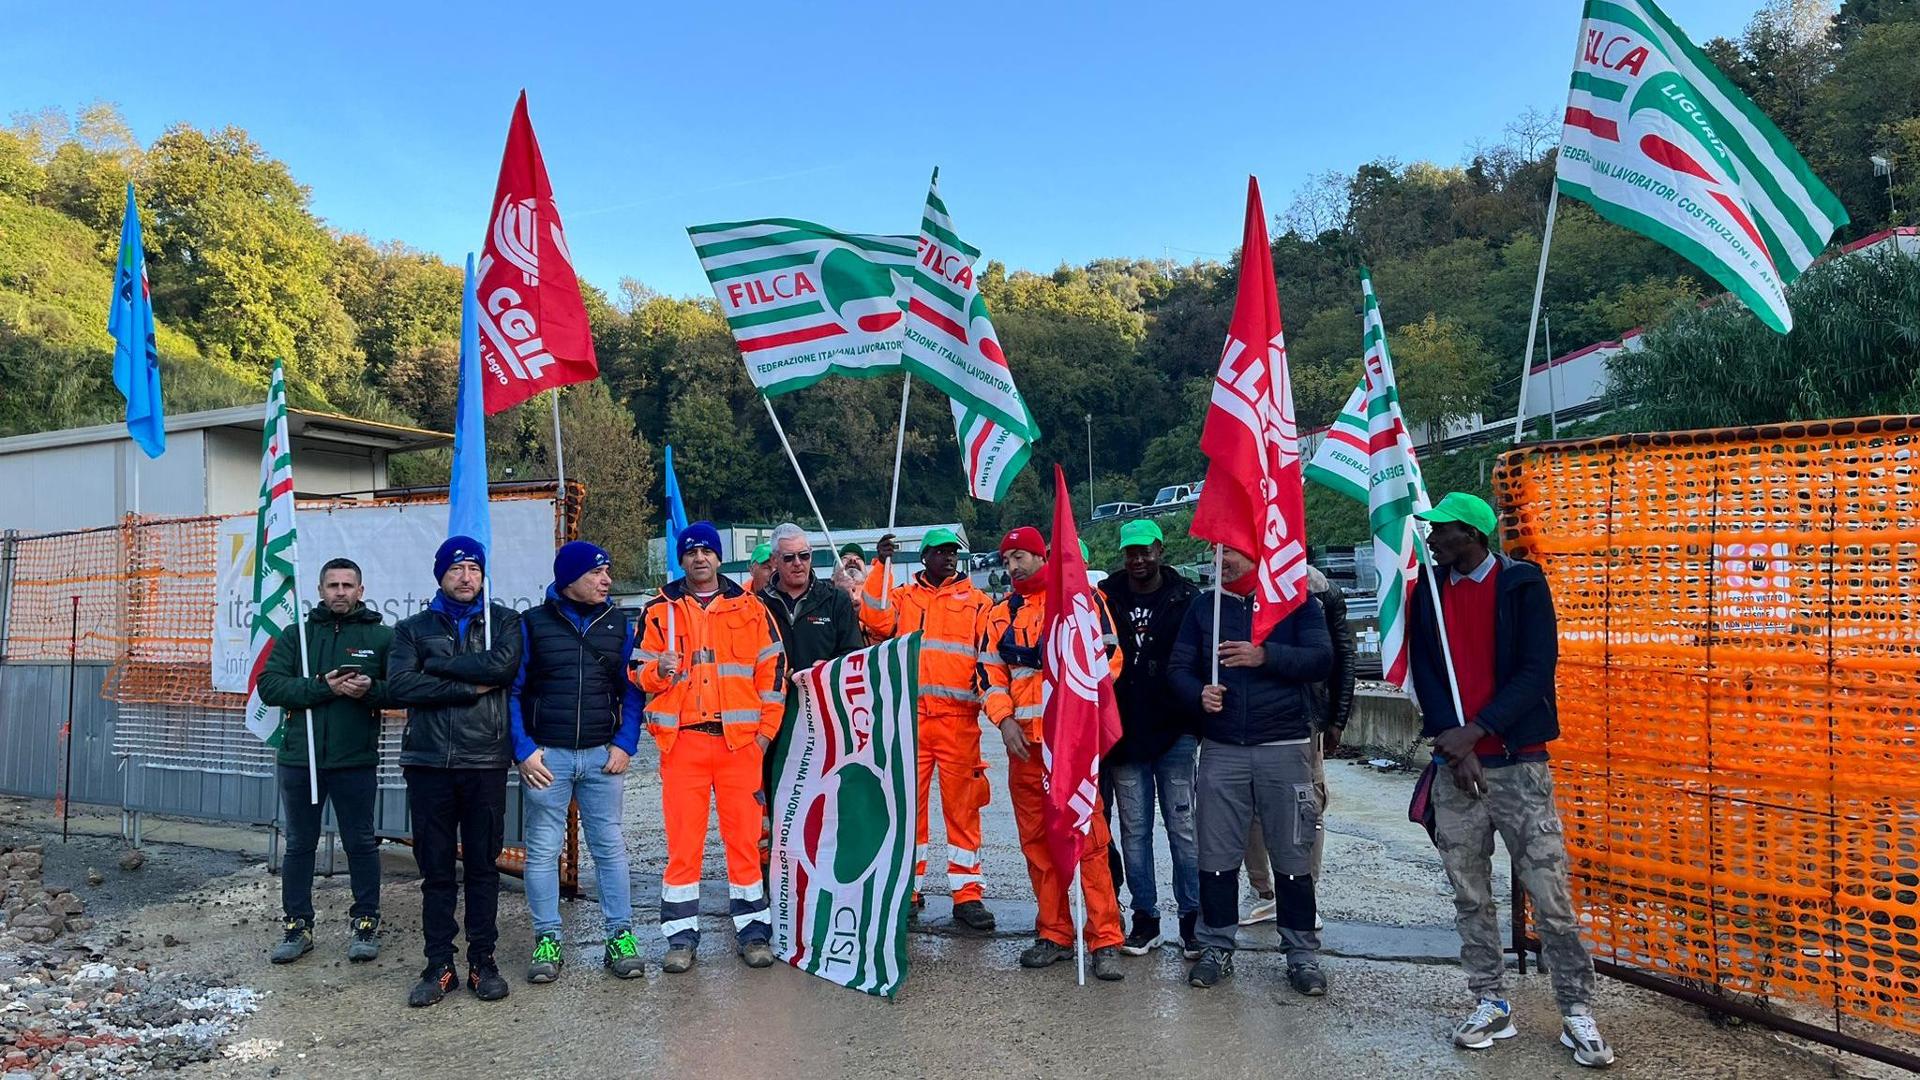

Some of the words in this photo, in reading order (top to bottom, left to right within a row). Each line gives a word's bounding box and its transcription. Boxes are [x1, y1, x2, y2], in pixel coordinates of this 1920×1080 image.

[1660, 83, 1727, 159] LIGURIA
[1610, 165, 1679, 202] LAVORATORI
[1678, 197, 1751, 260] COSTRUZIONI
[1750, 259, 1760, 270] E
[727, 271, 817, 309] FILCA
[488, 287, 556, 380] CGIL
[757, 351, 817, 374] FEDERAZIONE
[485, 352, 508, 385] Legno
[967, 364, 1013, 393] LAVORATORI
[225, 652, 249, 675] infr
[845, 653, 870, 753] FILCA
[796, 736, 815, 781] ITALIANA
[780, 784, 803, 847] LAVORATORI
[778, 850, 789, 920] COSTRUZIONI
[824, 906, 857, 973] CISL
